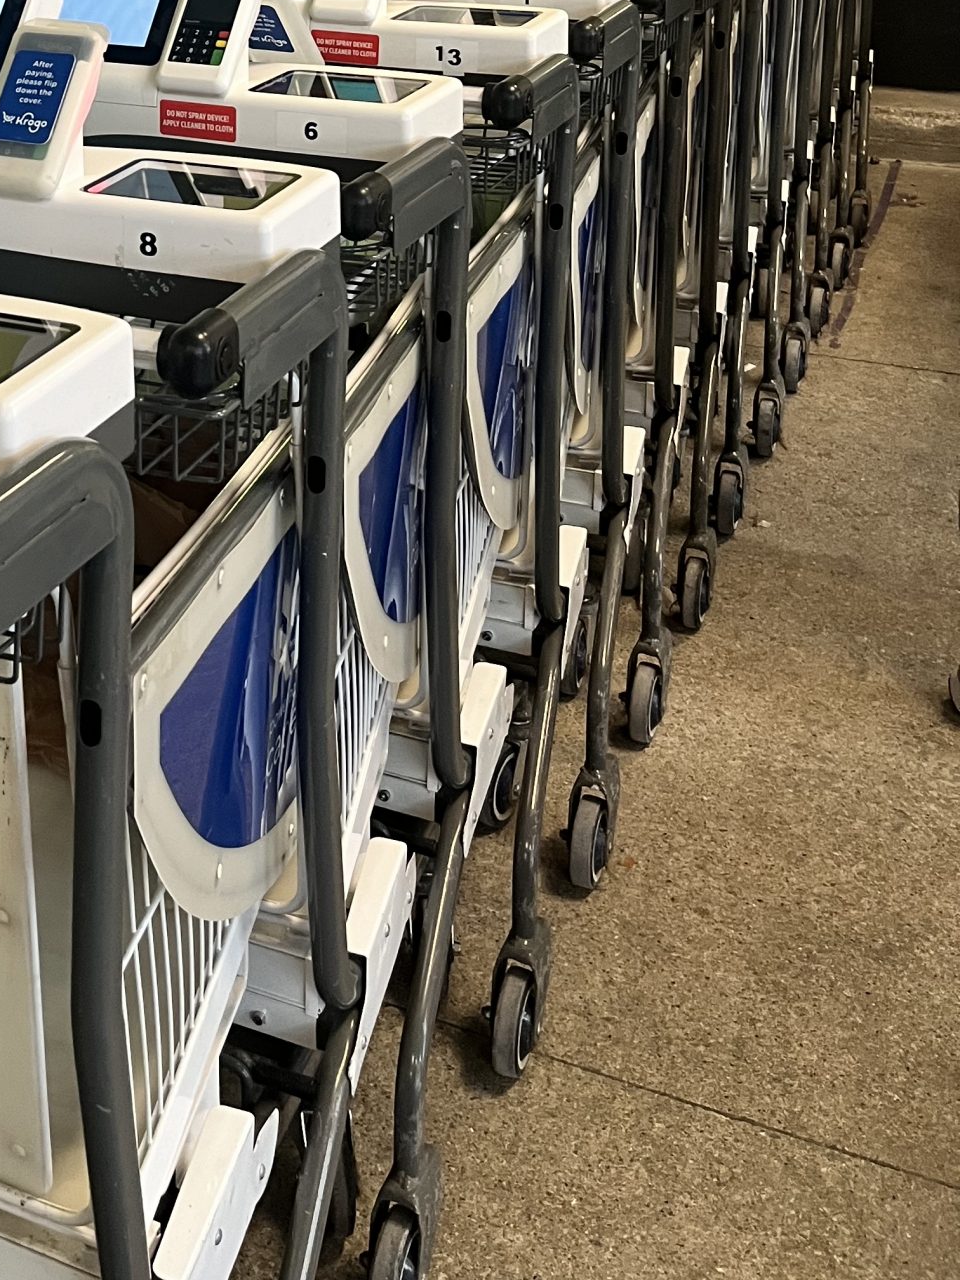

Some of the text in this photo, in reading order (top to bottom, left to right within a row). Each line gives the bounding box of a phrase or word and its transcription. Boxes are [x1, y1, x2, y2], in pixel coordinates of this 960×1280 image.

[435, 45, 462, 66] 13
[33, 60, 54, 68] After
[16, 78, 58, 88] please flip
[15, 87, 38, 95] down
[15, 112, 48, 133] Krogo
[166, 109, 175, 117] DO
[176, 110, 188, 119] NOT
[188, 111, 207, 121] SPRAY
[162, 119, 180, 128] APPLY
[180, 120, 206, 131] CLEANER
[215, 125, 234, 134] CLOTH
[304, 121, 319, 141] 6
[139, 231, 158, 257] 8
